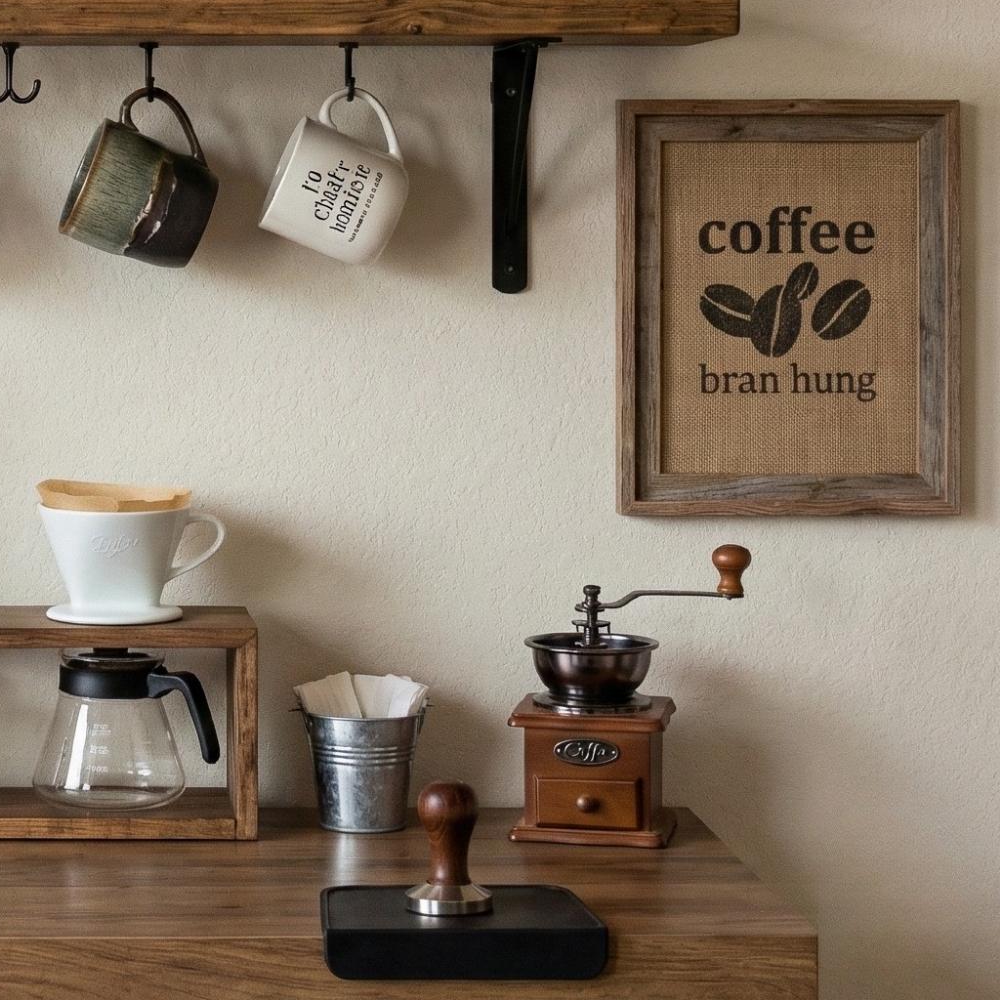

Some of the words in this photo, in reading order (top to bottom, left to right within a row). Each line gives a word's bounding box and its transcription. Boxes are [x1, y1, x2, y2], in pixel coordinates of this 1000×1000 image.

[699, 206, 875, 254] coffee
[699, 363, 780, 394] bran
[790, 363, 877, 402] hung
